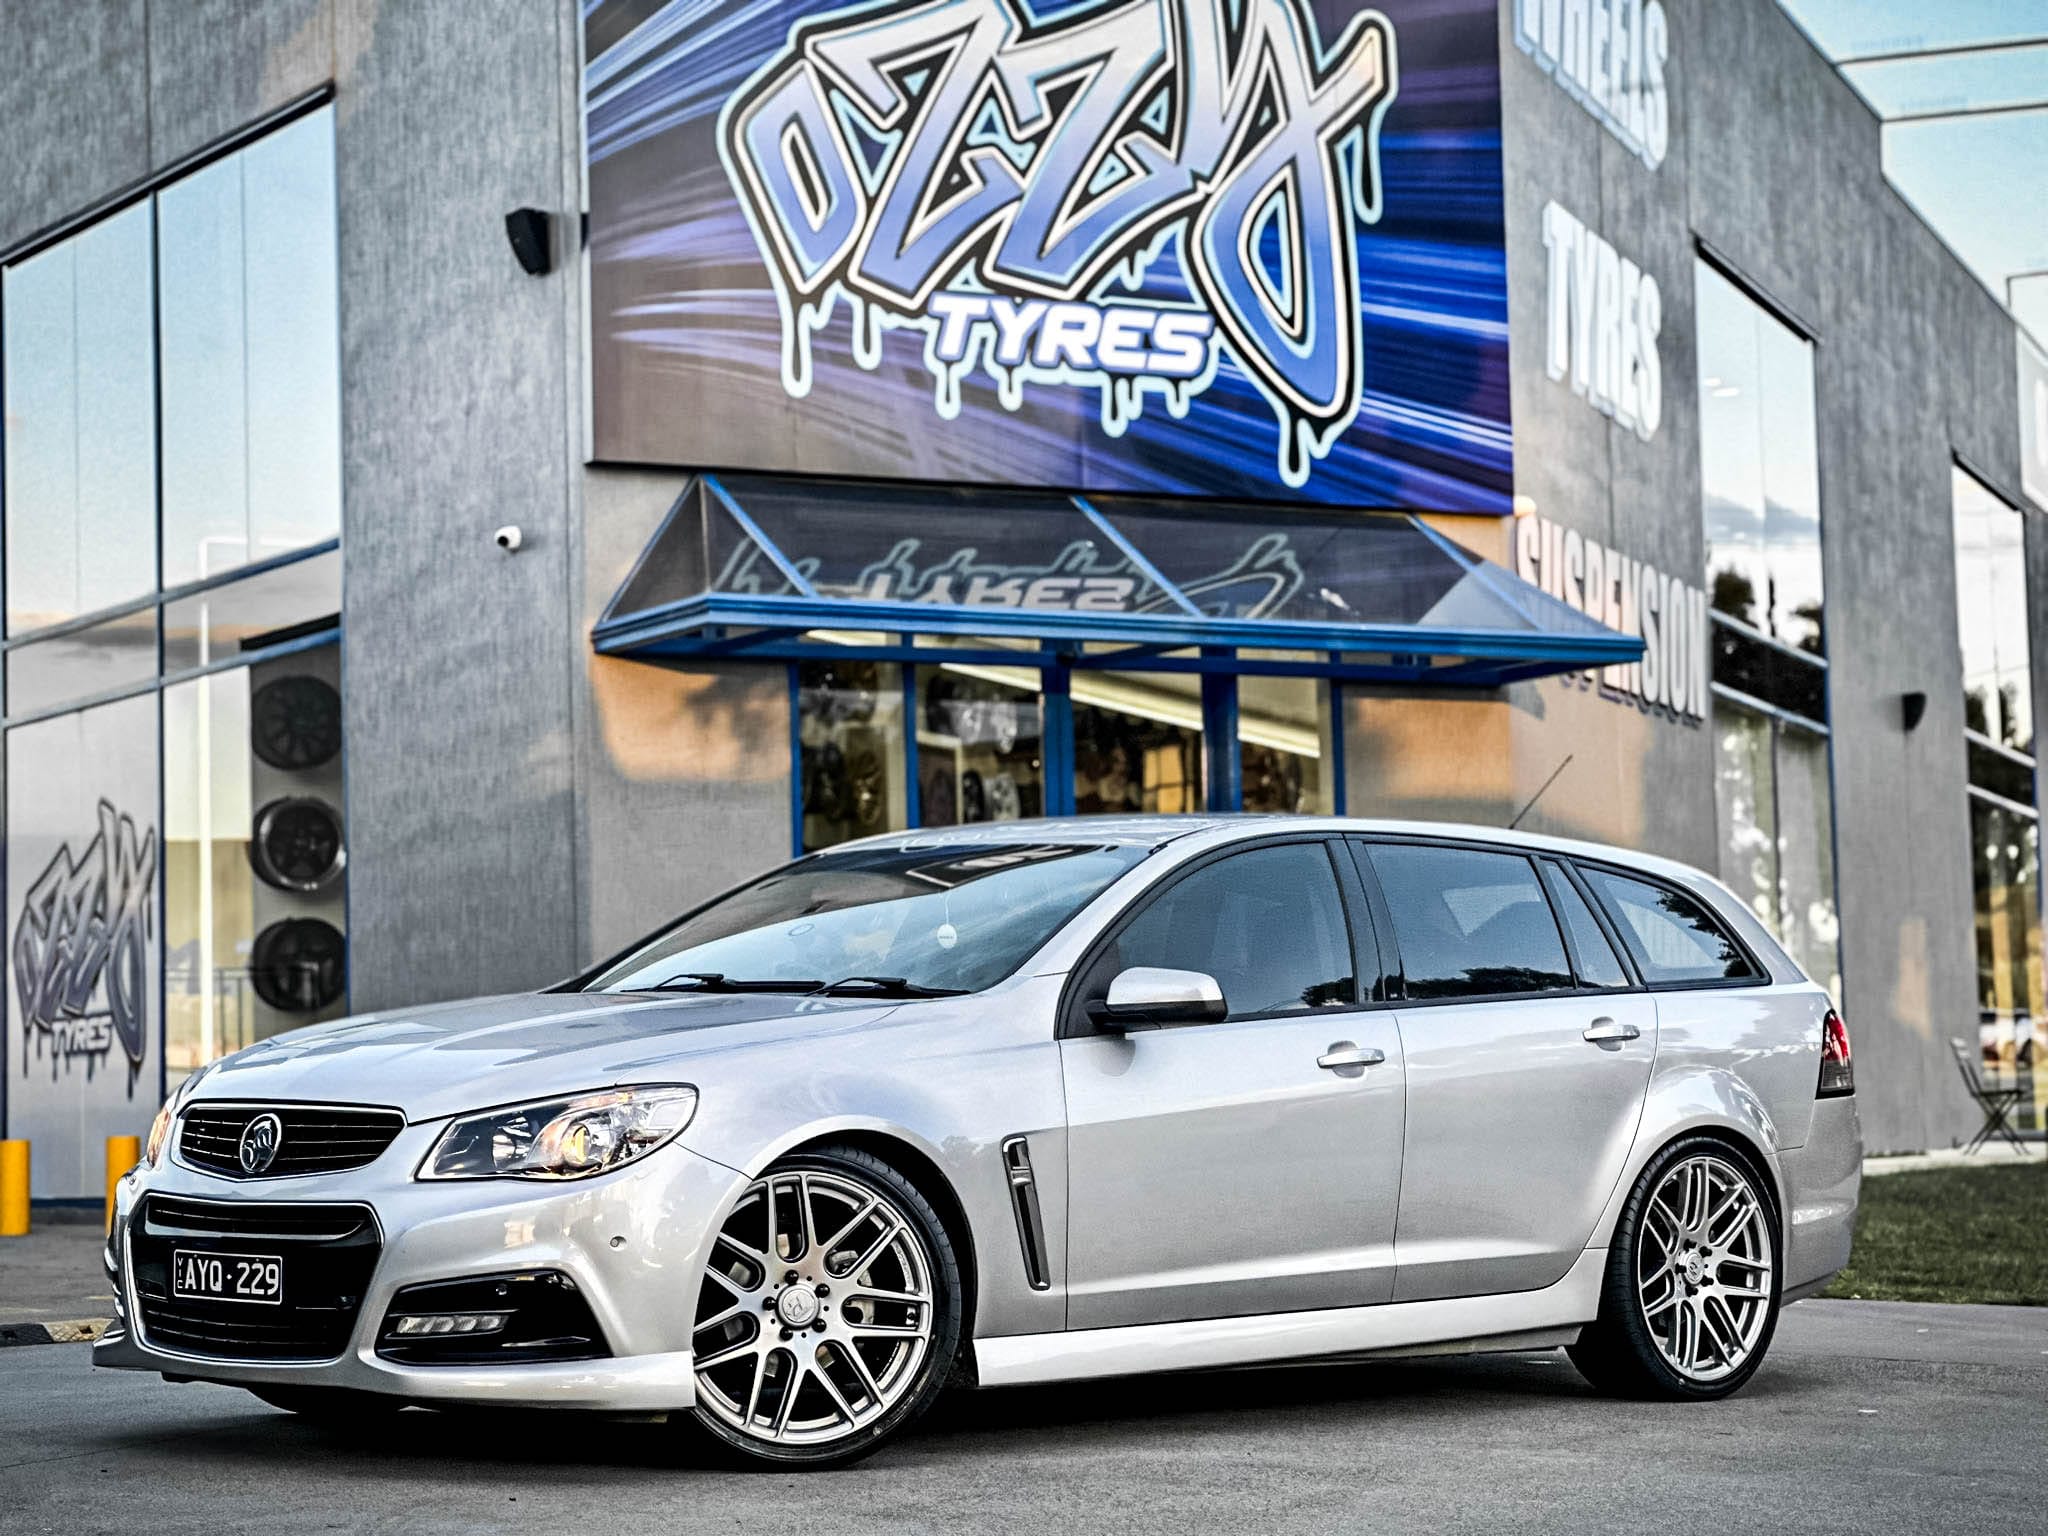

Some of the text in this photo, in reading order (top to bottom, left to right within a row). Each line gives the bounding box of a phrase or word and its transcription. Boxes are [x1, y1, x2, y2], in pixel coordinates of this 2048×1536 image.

[1513, 0, 1669, 172] HEELS
[929, 294, 1215, 375] TYRES
[1542, 199, 1662, 442] TYRES
[50, 1013, 113, 1053] TYRES
